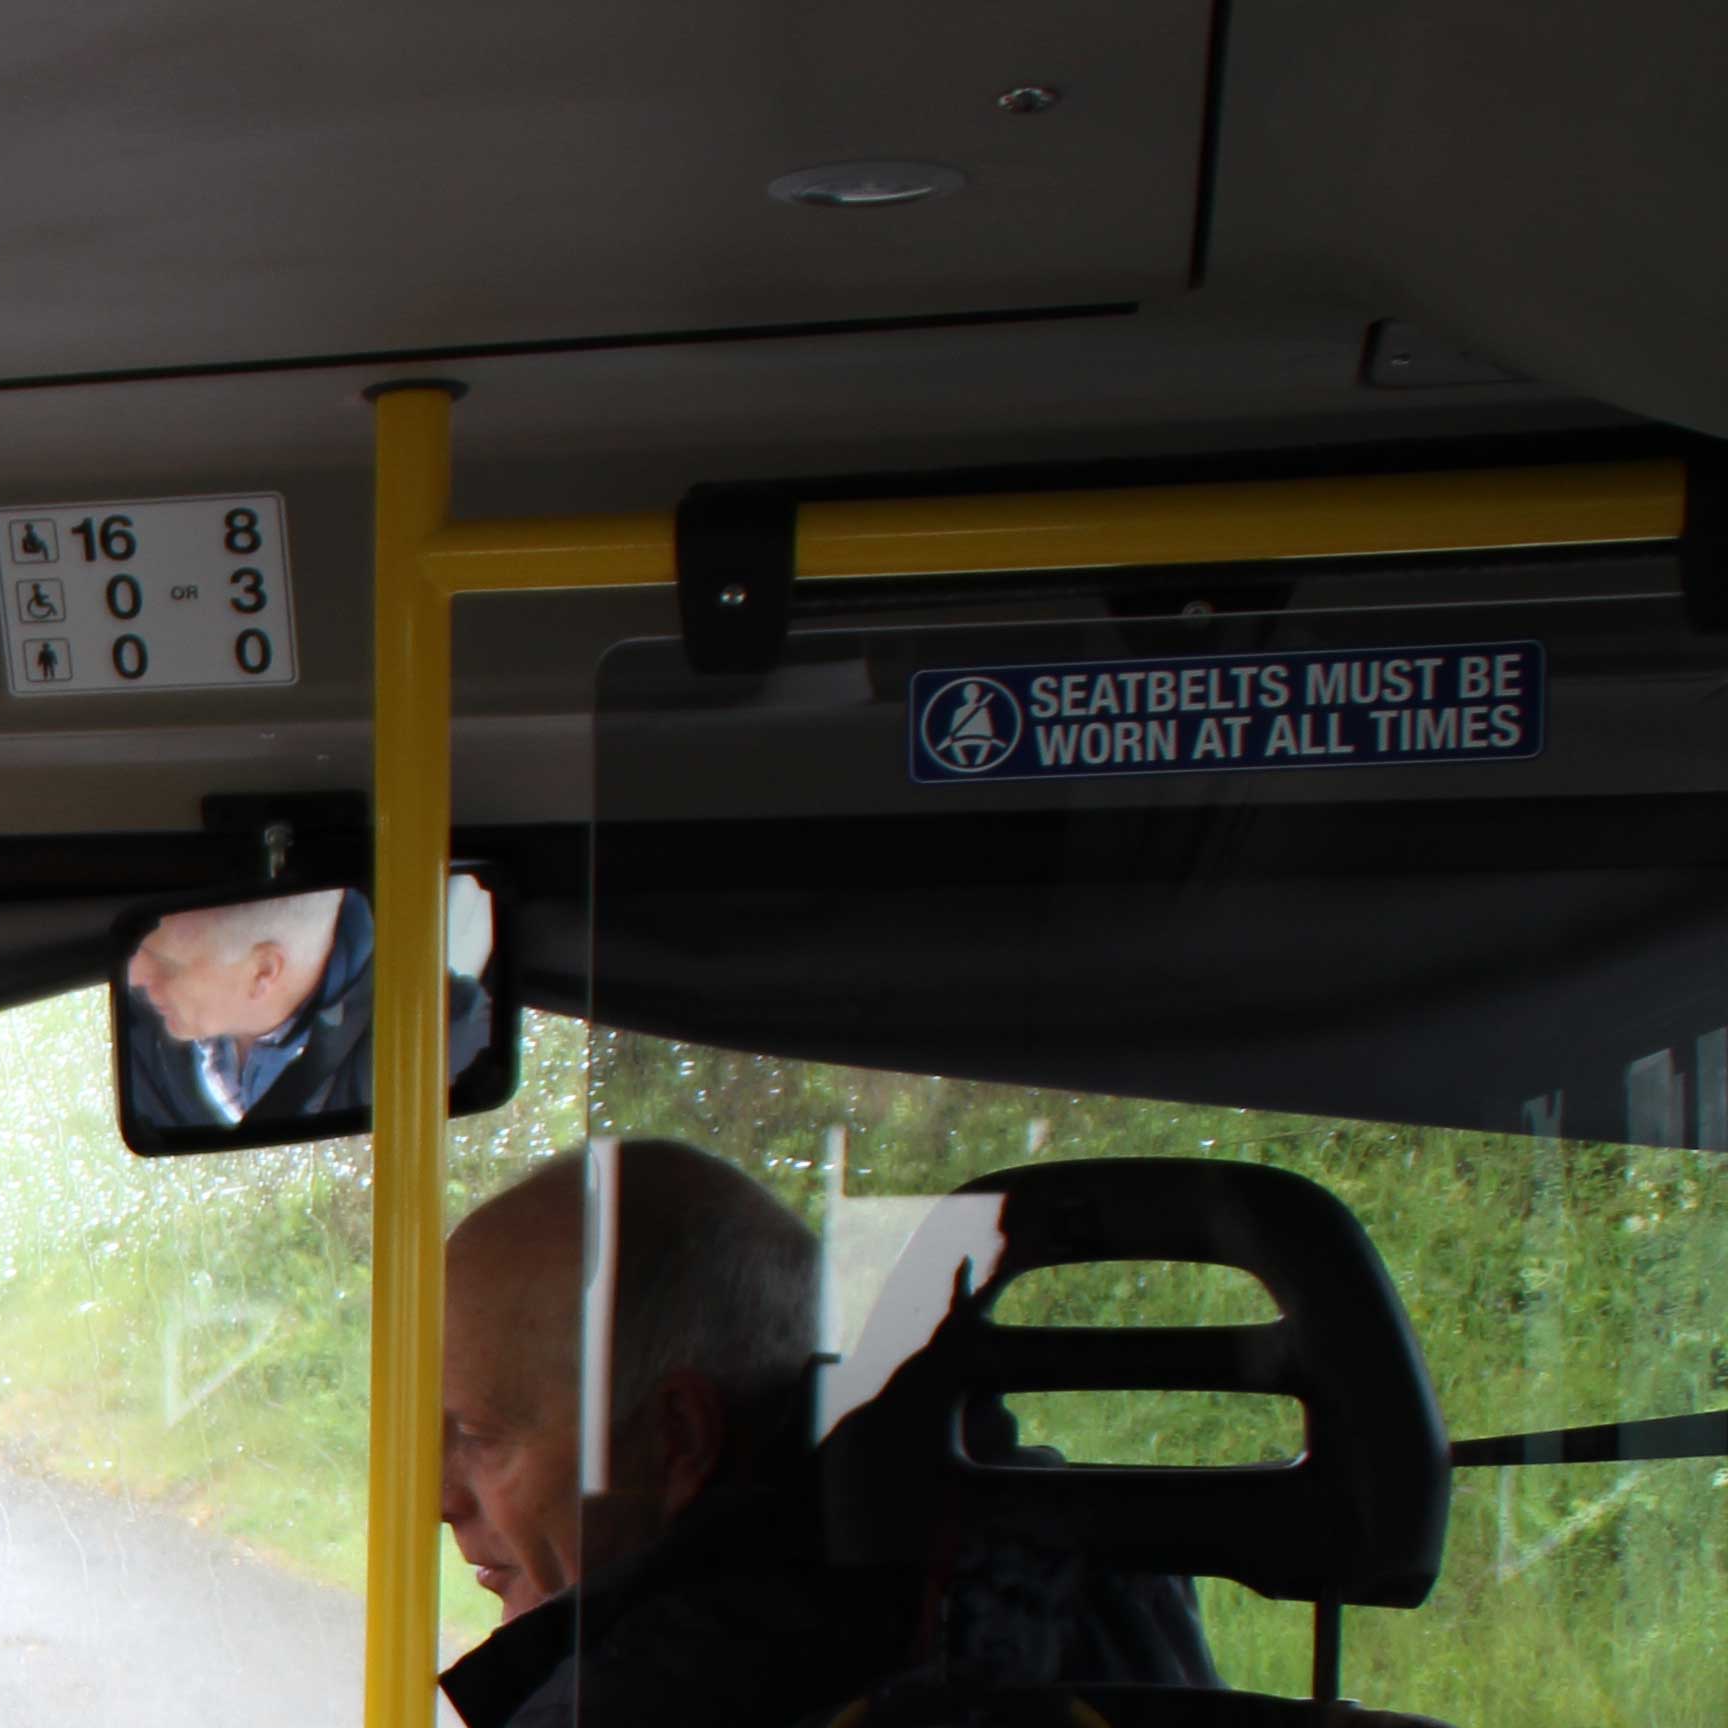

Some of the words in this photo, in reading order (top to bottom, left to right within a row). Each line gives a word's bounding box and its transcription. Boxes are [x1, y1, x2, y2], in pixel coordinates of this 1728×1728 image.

[70, 514, 137, 563] 16
[223, 507, 262, 555] 8
[106, 574, 143, 621] 0
[170, 585, 199, 602] OR
[229, 567, 268, 615] 3
[112, 633, 149, 680] 0
[234, 628, 272, 675] 0
[1029, 664, 1291, 720] SEATBELTS
[1304, 657, 1445, 706] MUST
[1456, 653, 1524, 700] BE
[1034, 718, 1180, 768] WORN
[1191, 714, 1253, 760] AT
[1263, 711, 1356, 758] ALL
[1368, 704, 1523, 753] TIMES
